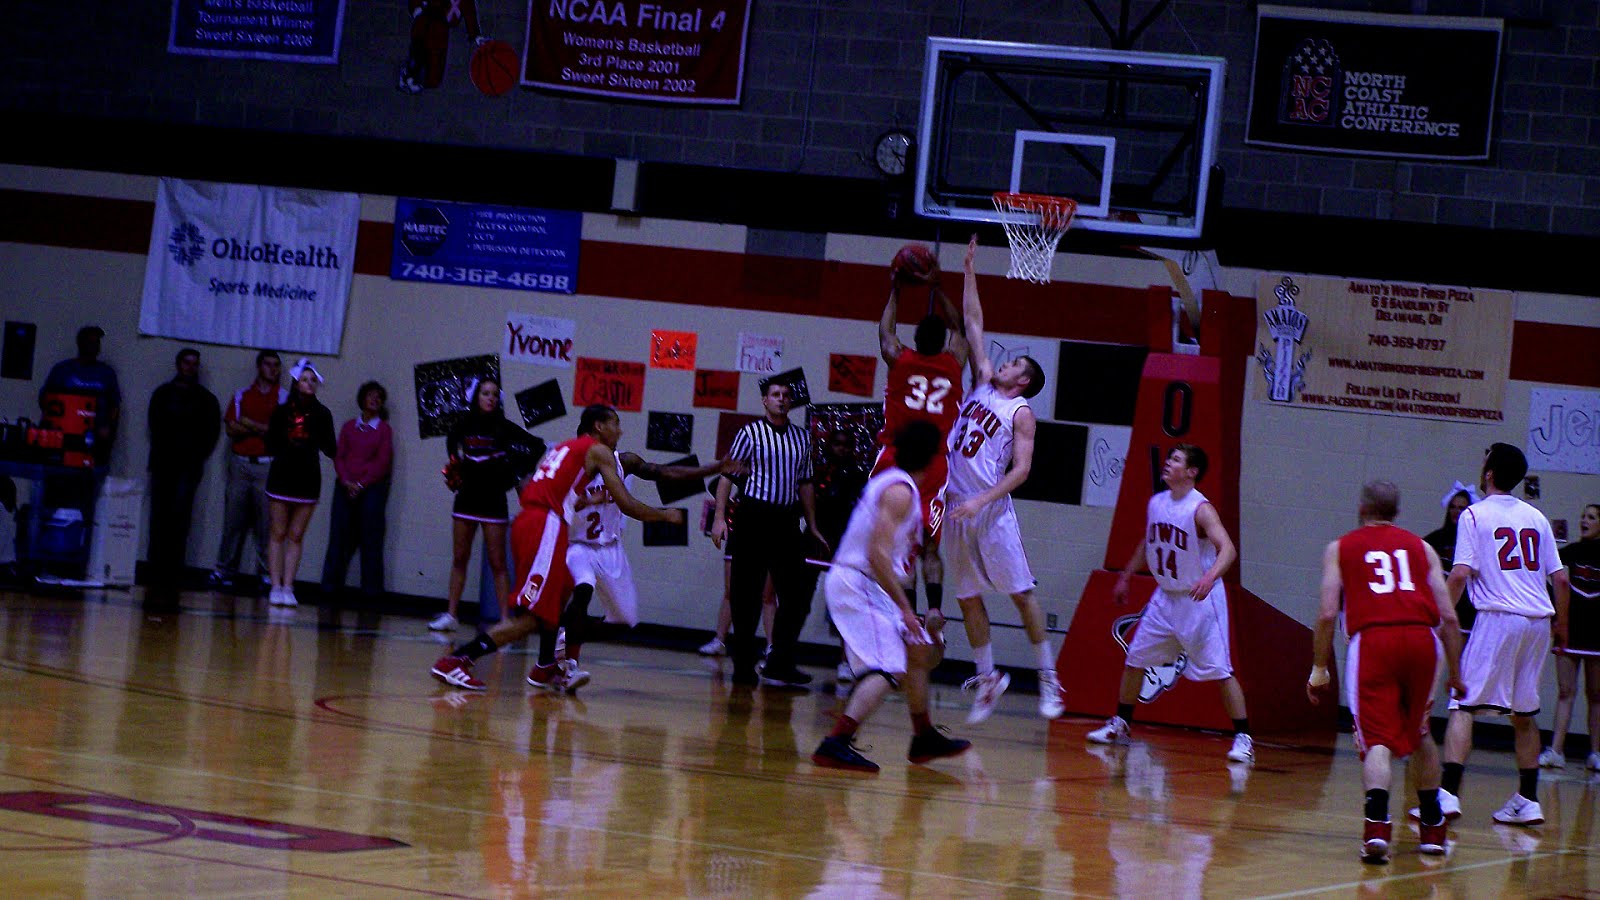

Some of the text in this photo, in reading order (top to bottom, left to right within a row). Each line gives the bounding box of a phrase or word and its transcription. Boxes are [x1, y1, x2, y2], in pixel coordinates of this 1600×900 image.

[198, 10, 313, 30] Tournament Winner
[549, 0, 727, 33] NCAA Final 4
[195, 27, 233, 41] Sweet
[236, 30, 280, 46] Sixteen
[563, 31, 701, 57] Women's Basketball
[578, 52, 680, 75] 3rd Place 2001
[561, 67, 697, 93] Sweet Sixteen 2002
[1344, 70, 1407, 89] NORTH
[1343, 86, 1403, 103] COAST
[1341, 100, 1430, 120] ATHLETIC
[1340, 116, 1461, 138] CONFERENCE
[212, 238, 340, 269] OhioHealth
[520, 247, 566, 258] DETECTION
[401, 262, 570, 290] 740-362-4698
[209, 277, 317, 301] Sports Medicine
[1391, 284, 1419, 298] WOOD
[1421, 286, 1446, 300] FIRED
[1448, 288, 1474, 302] PIZZA
[1437, 301, 1450, 313] ST
[1428, 313, 1443, 326] OH
[506, 321, 574, 362] Yvonne
[1368, 333, 1447, 351] 740-369-8797
[904, 374, 953, 415] 32
[586, 511, 604, 540] 2
[1494, 527, 1541, 571] 20
[1156, 547, 1178, 580] 14
[1363, 549, 1416, 594] 31
